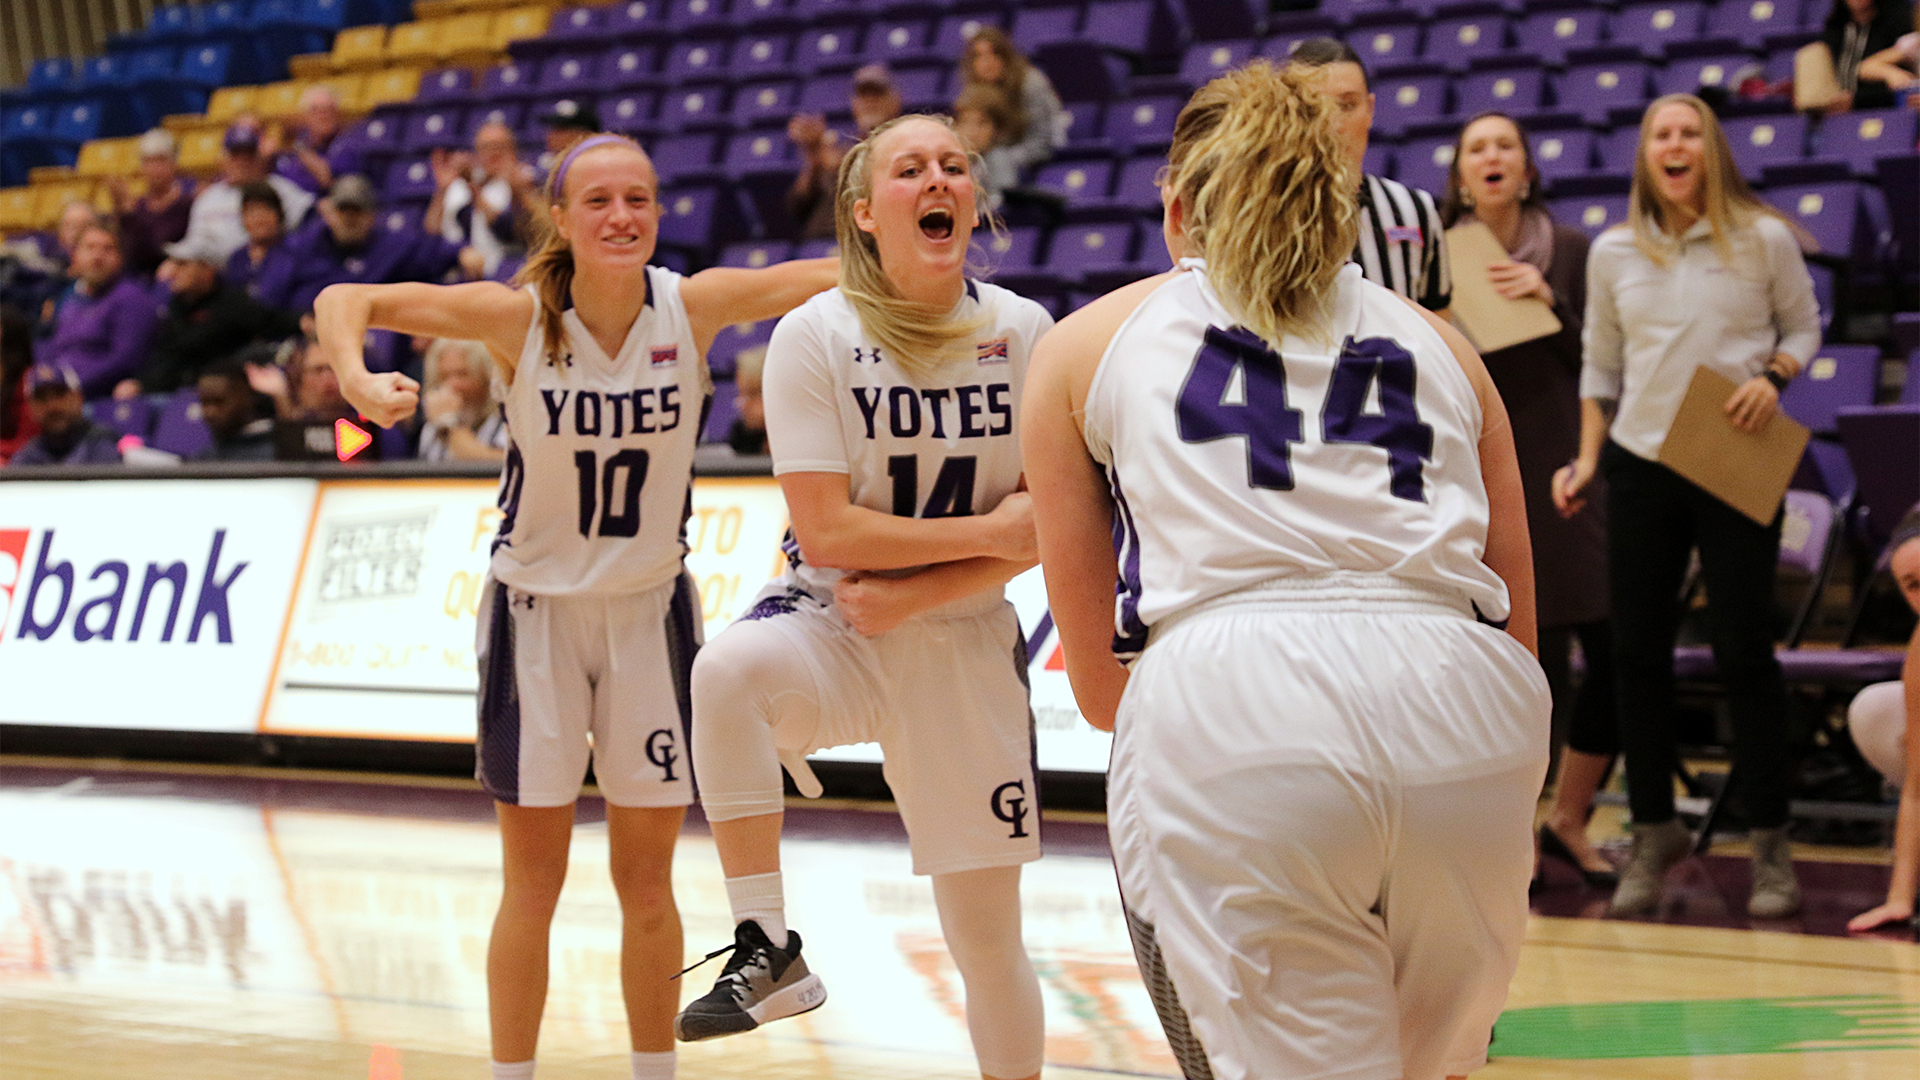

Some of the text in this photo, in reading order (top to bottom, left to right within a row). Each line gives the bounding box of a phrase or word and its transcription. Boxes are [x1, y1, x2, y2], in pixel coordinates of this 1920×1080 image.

[540, 384, 681, 438] YOTES
[851, 383, 1012, 439] YOTES
[1175, 324, 1434, 504] 44
[574, 449, 649, 539] 10
[887, 454, 976, 518] 14
[17, 528, 249, 644] bank
[320, 558, 422, 603] FILTER
[366, 642, 430, 670] QUIT
